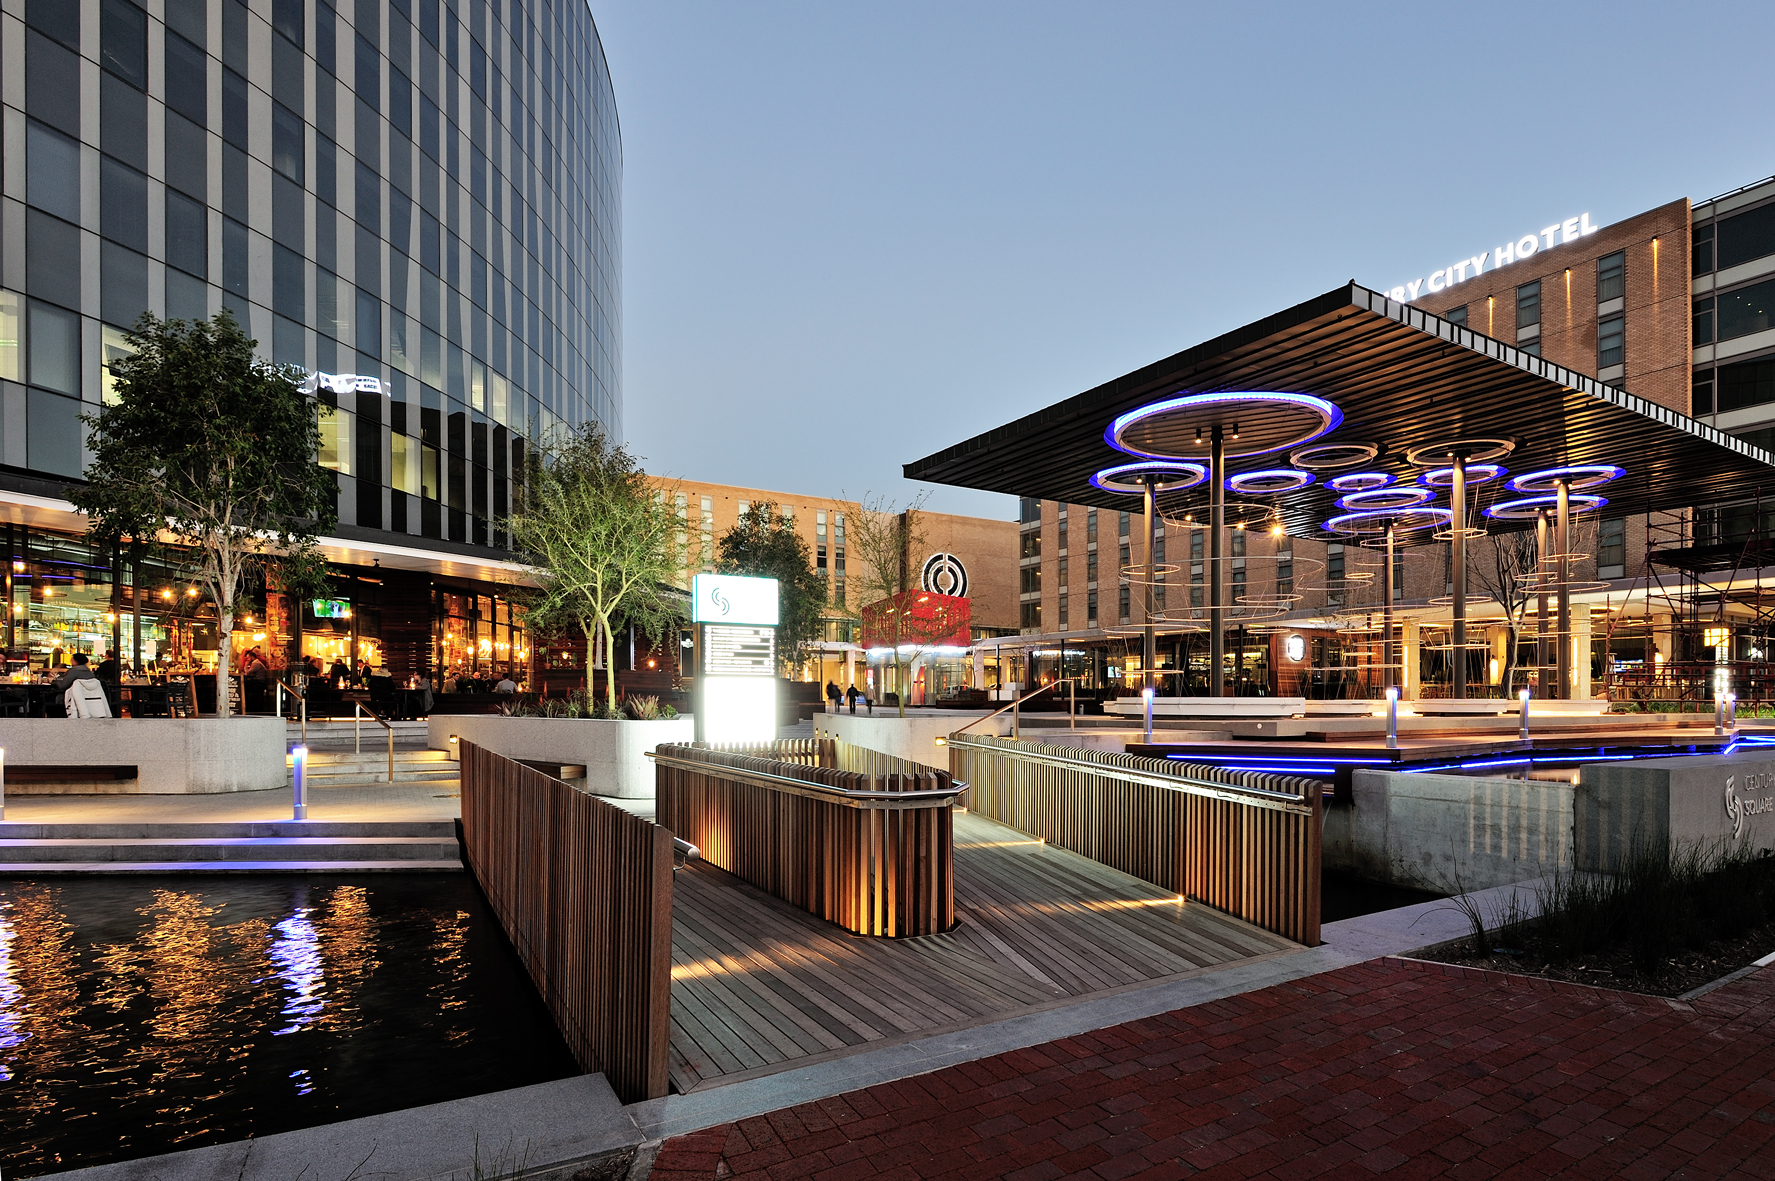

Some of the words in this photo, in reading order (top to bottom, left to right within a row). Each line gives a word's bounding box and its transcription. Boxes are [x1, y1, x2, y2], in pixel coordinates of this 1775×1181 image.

[1383, 278, 1424, 304] RY
[1427, 251, 1489, 293] CITY
[1494, 212, 1599, 269] HOTEL
[1744, 772, 1775, 791] CENTUR
[1744, 797, 1773, 816] SQUARE
